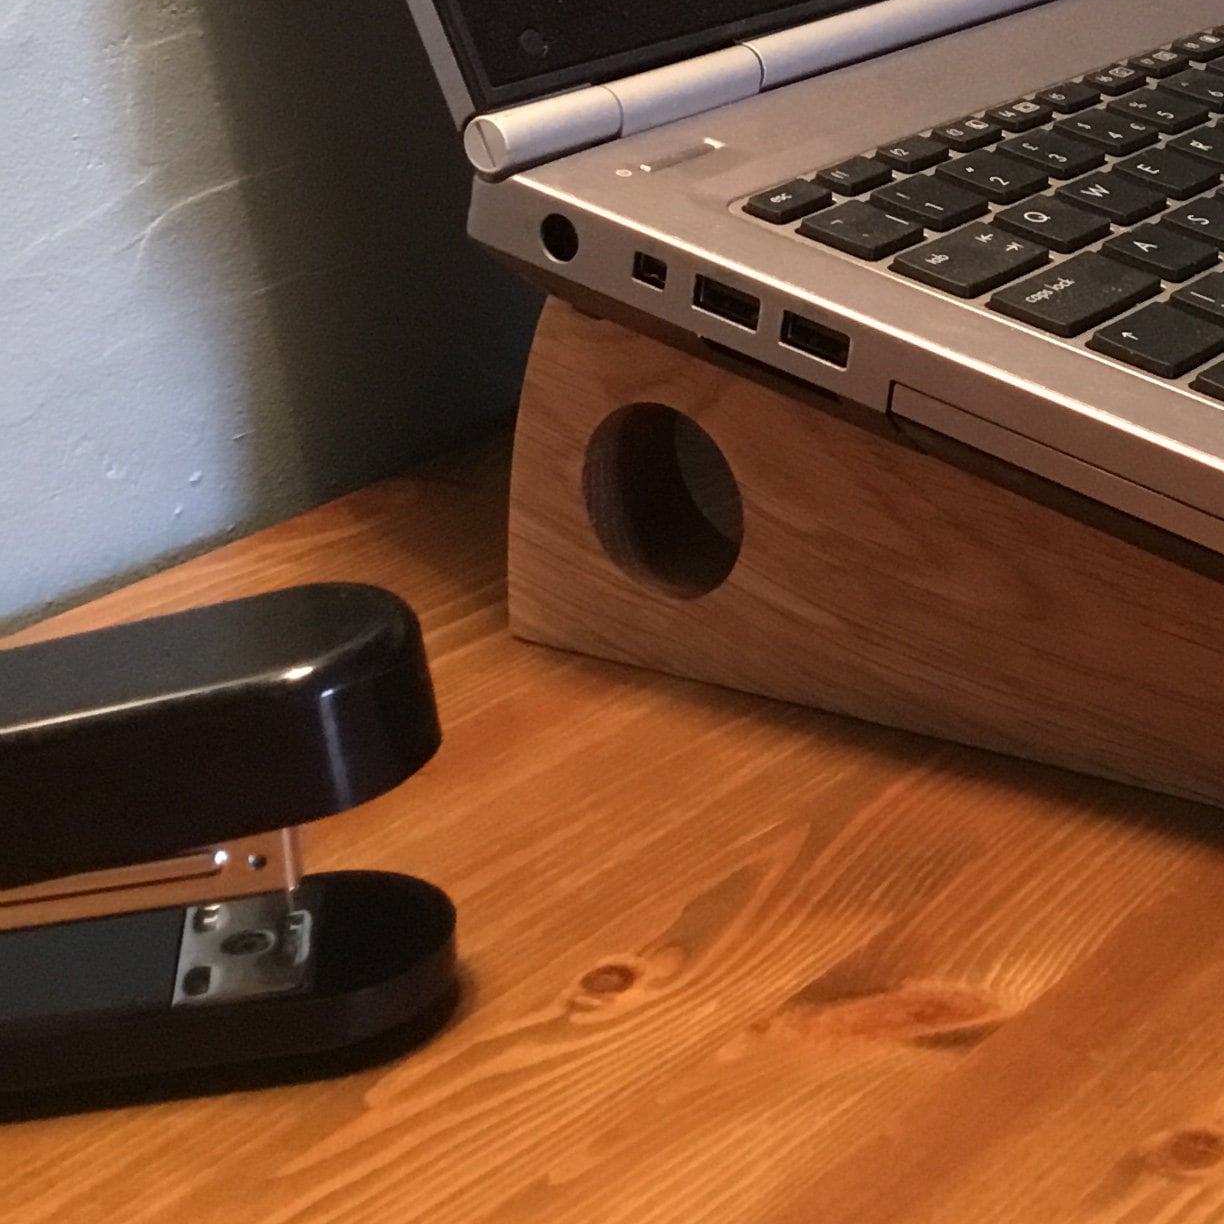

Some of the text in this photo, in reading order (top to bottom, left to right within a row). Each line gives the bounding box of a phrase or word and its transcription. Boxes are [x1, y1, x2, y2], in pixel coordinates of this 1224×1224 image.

[1156, 109, 1175, 120] 5
[1189, 138, 1213, 152] R
[1048, 153, 1068, 163] 3
[1136, 162, 1161, 175] E
[989, 175, 1009, 186] 2
[1080, 183, 1111, 198] W
[1023, 210, 1051, 223] Q
[1187, 214, 1210, 225] S
[1133, 240, 1158, 253] A
